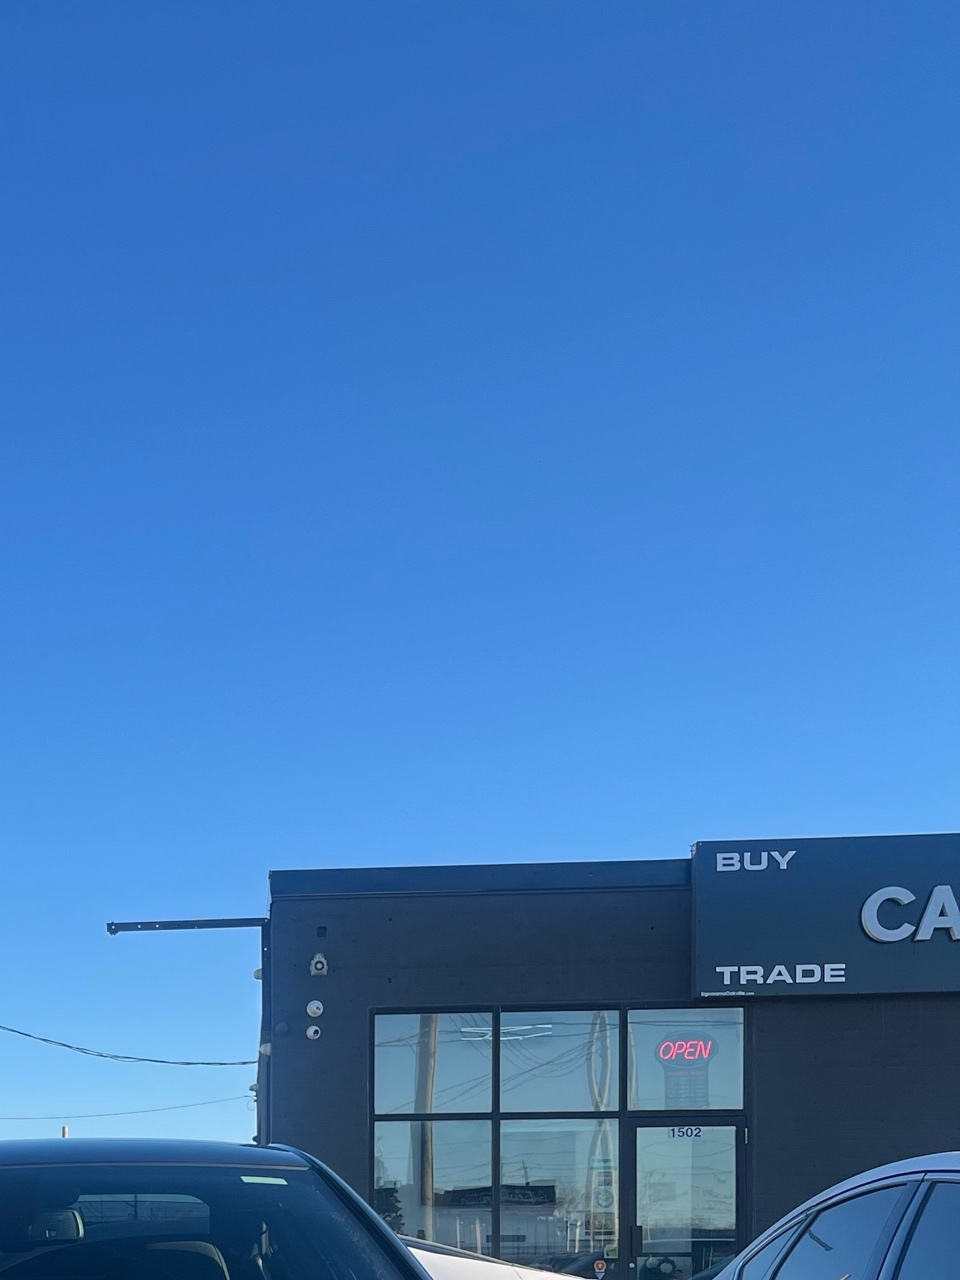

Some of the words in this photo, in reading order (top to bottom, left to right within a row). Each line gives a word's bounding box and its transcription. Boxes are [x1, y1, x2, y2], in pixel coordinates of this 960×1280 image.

[716, 850, 797, 872] BUY
[861, 885, 960, 943] CA
[715, 963, 846, 985] TRADE
[659, 1040, 712, 1060] OPEN
[670, 1127, 701, 1138] 1502
